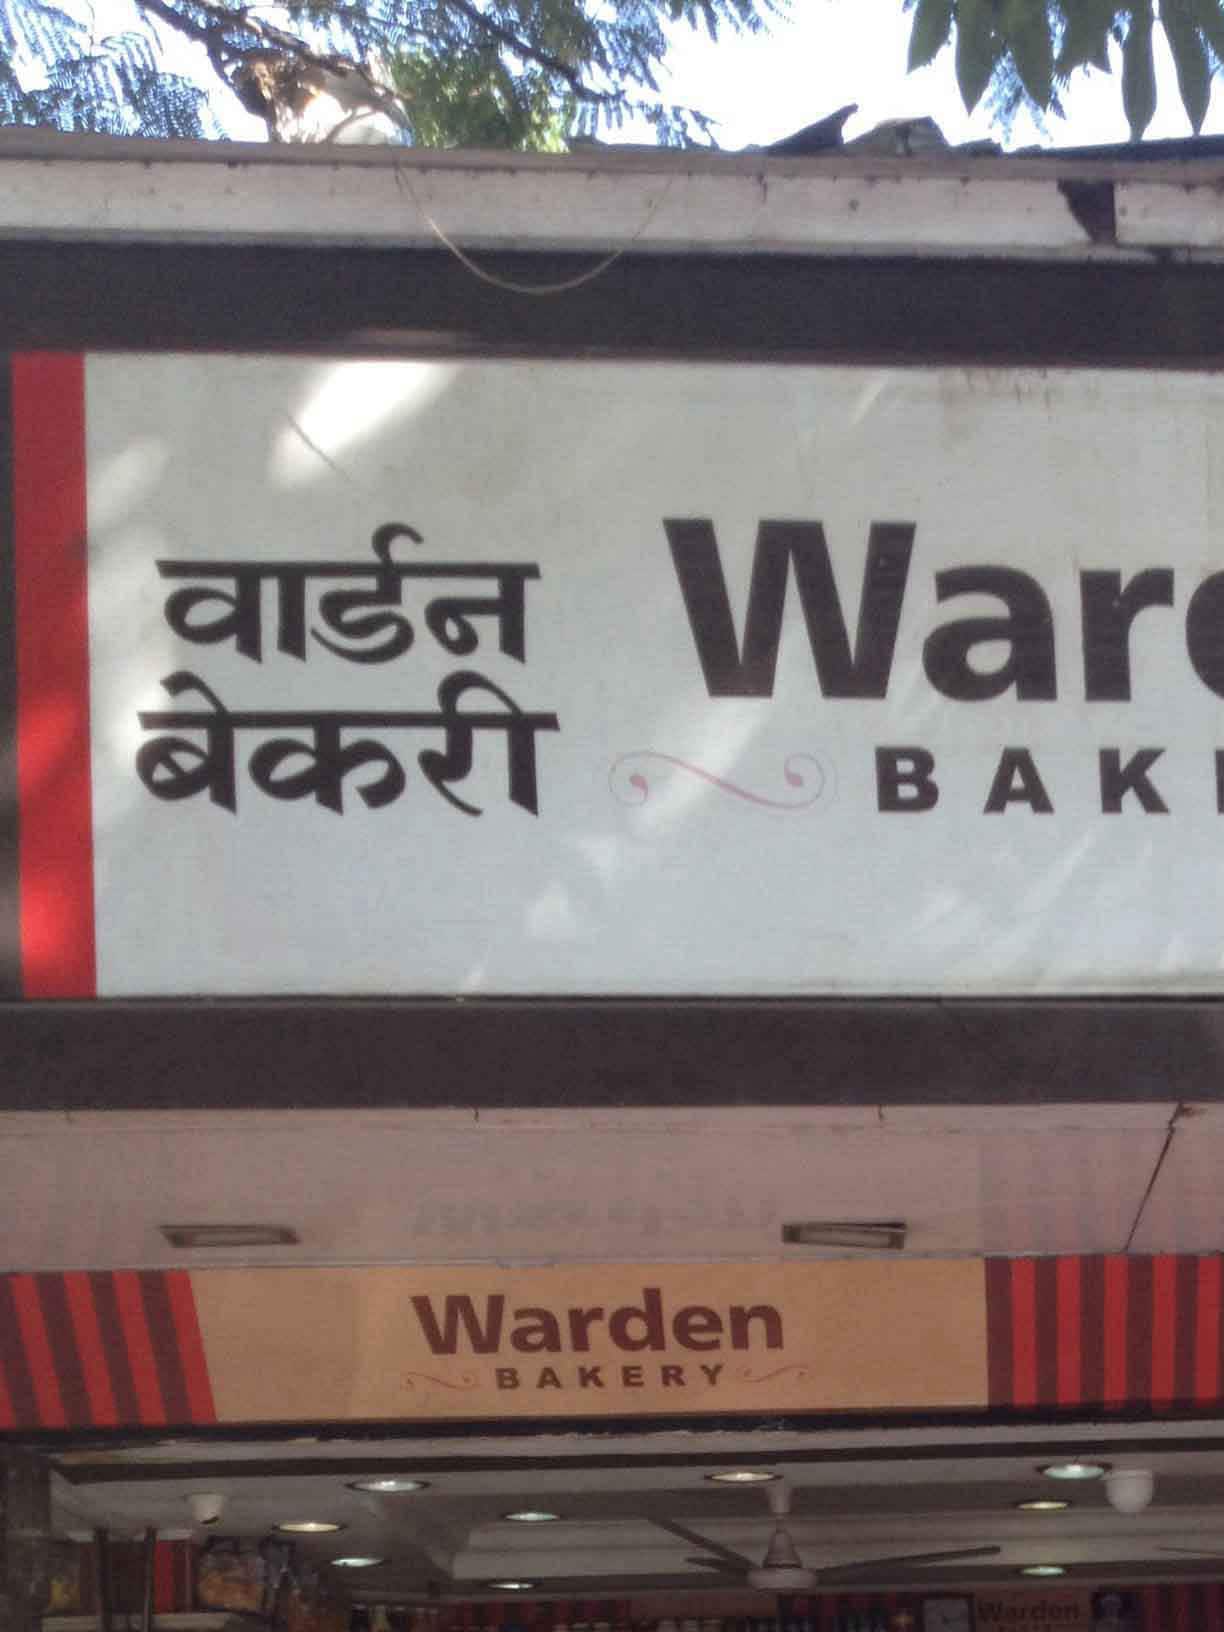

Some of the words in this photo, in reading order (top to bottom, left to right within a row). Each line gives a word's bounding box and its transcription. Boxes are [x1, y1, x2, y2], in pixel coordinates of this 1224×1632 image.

[155, 522, 542, 664] वार्डन
[135, 669, 561, 817] बेकरी
[410, 1287, 784, 1355] Warden
[495, 1364, 724, 1390] BAKERY
